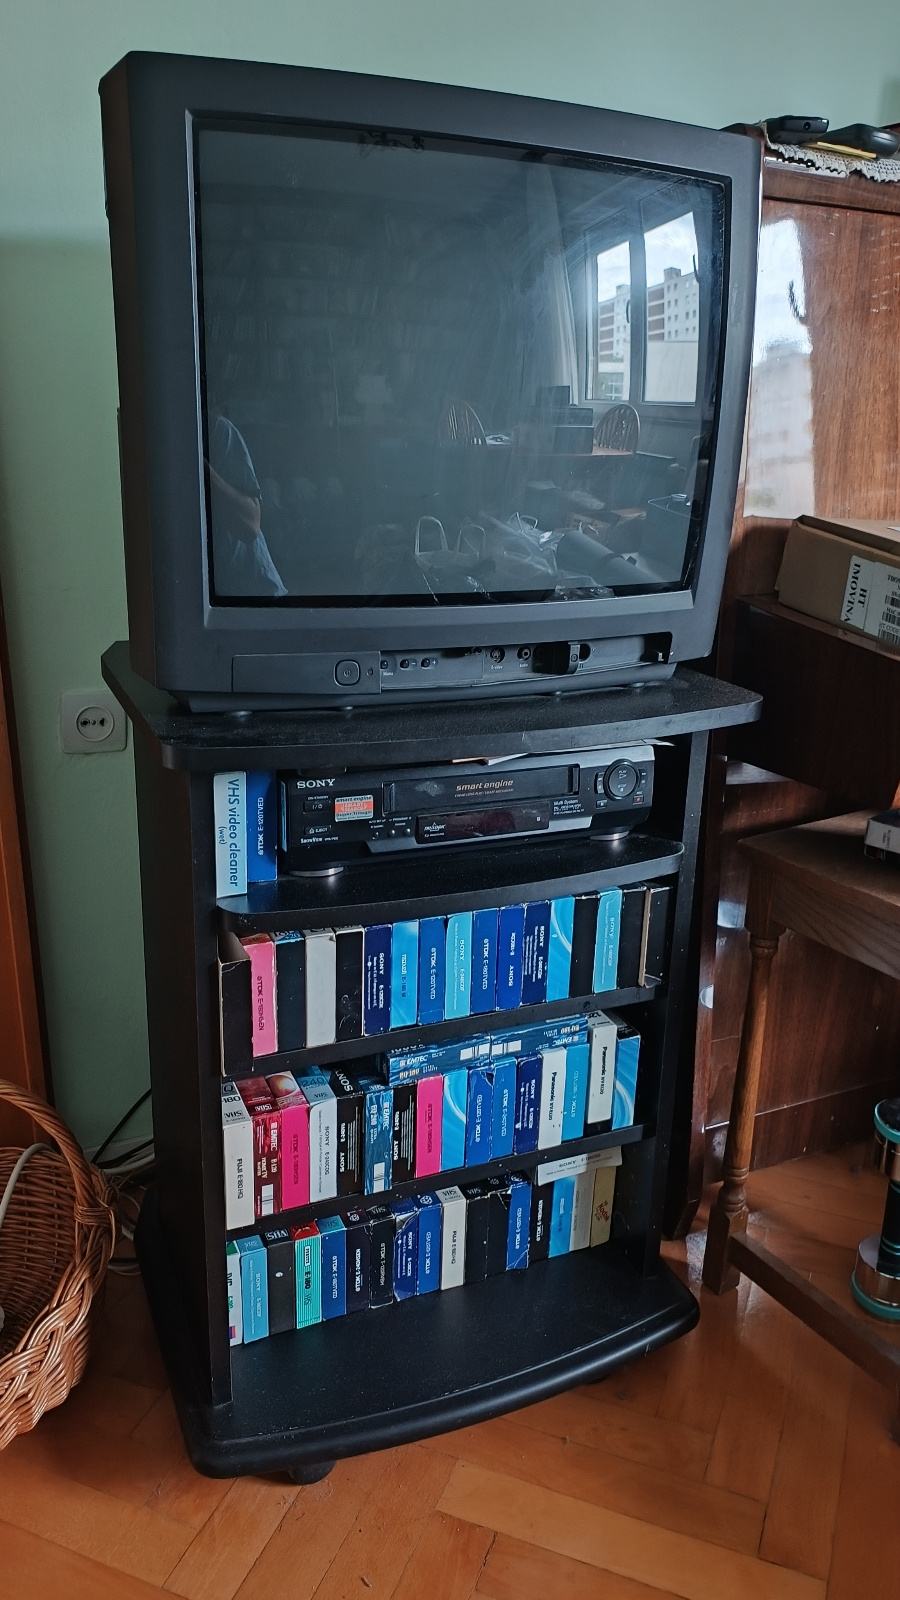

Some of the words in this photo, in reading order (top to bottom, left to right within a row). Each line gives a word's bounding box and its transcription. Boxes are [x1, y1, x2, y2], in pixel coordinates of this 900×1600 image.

[844, 563, 862, 622] IMOVINA
[858, 588, 868, 608] HT
[228, 778, 240, 805] VHS
[296, 778, 335, 789] SONY
[456, 783, 482, 791] smart
[484, 779, 513, 789] engine
[228, 807, 240, 839] video
[218, 826, 227, 845] (wet)
[229, 842, 240, 887] cleaner
[407, 1055, 429, 1065] EMTEC
[265, 1229, 287, 1240] VHS
